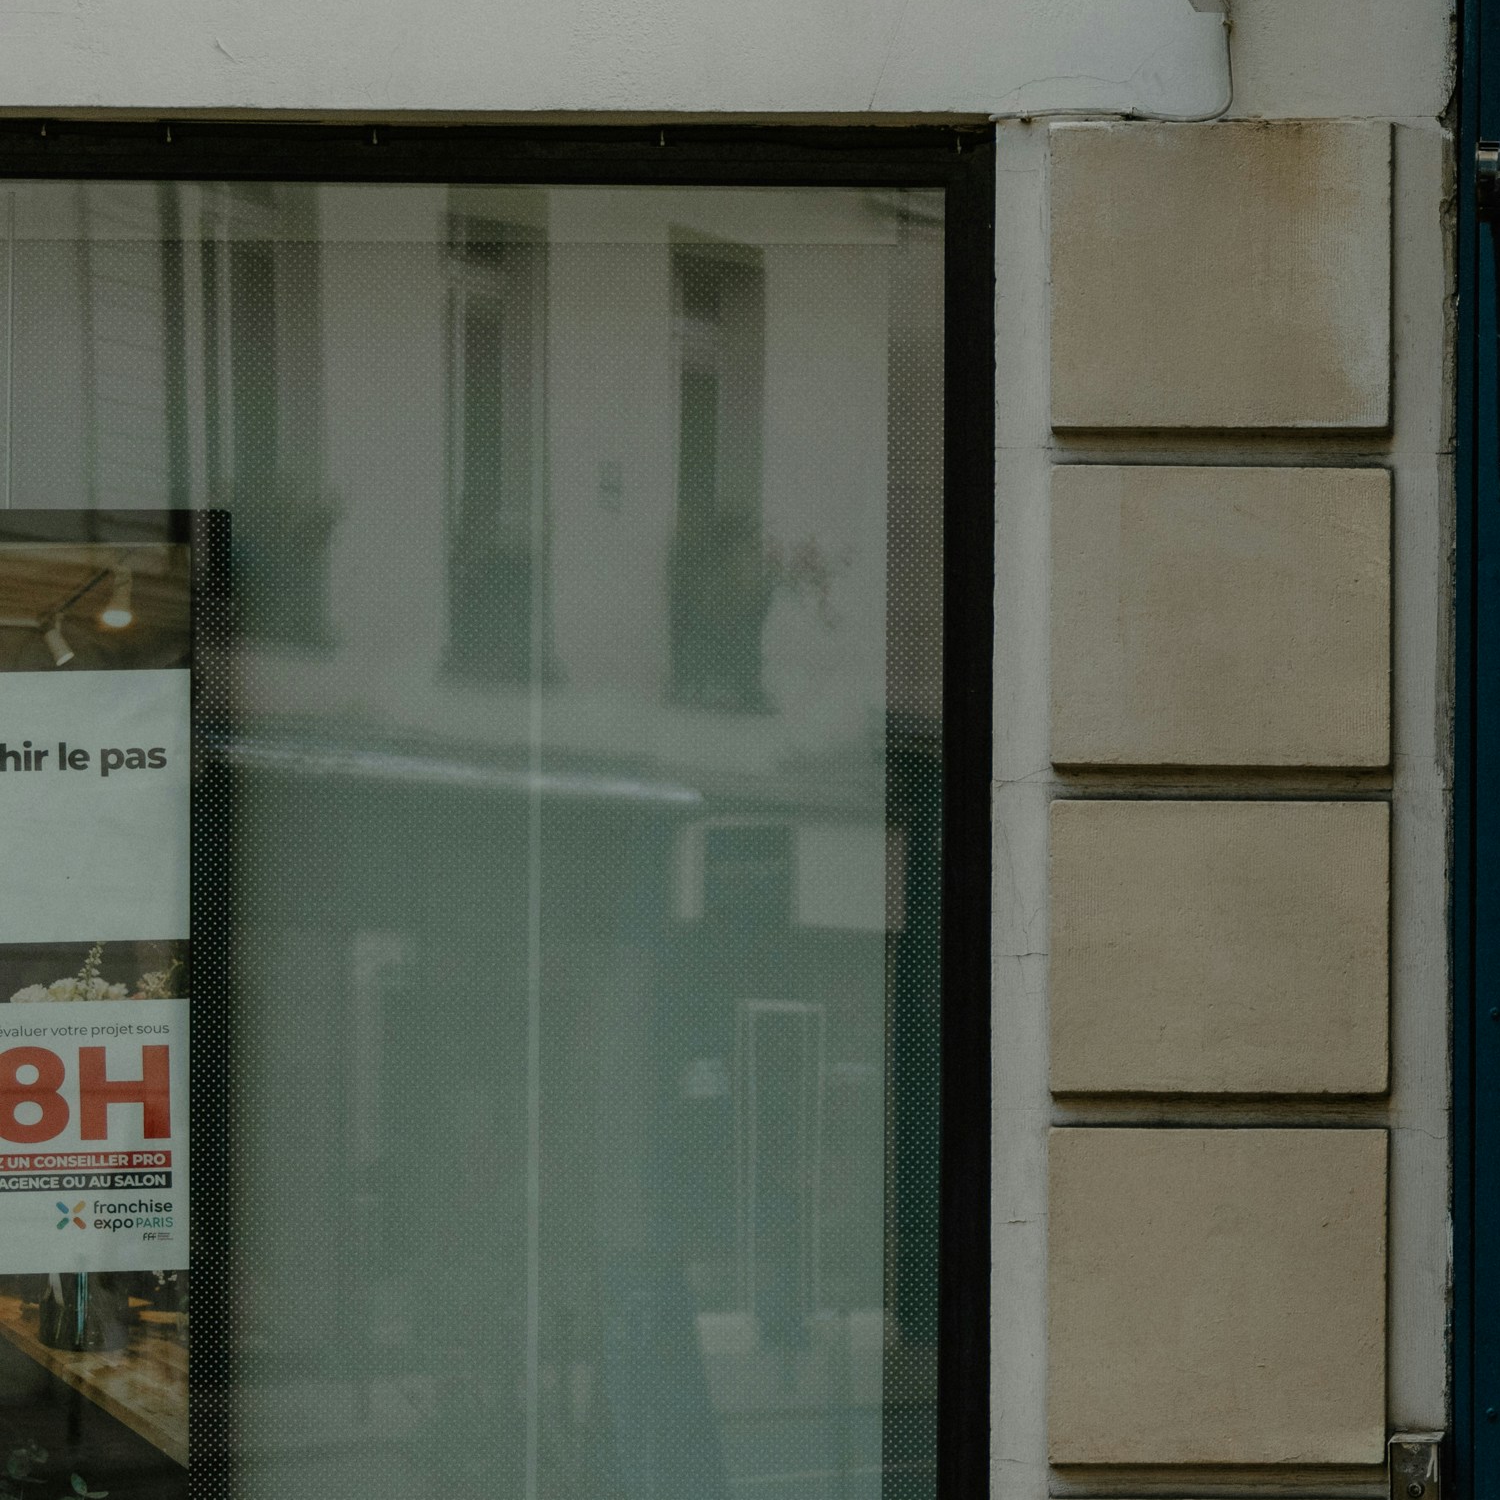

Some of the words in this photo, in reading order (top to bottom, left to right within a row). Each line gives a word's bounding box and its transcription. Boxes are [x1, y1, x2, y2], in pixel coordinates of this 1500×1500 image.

[0, 740, 49, 772] hir
[58, 742, 91, 771] le
[100, 747, 168, 777] pas
[51, 1025, 88, 1037] votre
[91, 1023, 134, 1038] projet
[136, 1024, 170, 1035] sous
[0, 1044, 171, 1144] 8H
[7, 1156, 31, 1169] UN
[34, 1154, 129, 1169] CONSEILLER
[132, 1153, 166, 1166] PRO
[0, 1177, 60, 1190] AGENCE
[62, 1176, 86, 1189] OU
[89, 1175, 111, 1188] AU
[114, 1174, 166, 1187] SALON
[93, 1199, 173, 1215] franchise
[93, 1217, 134, 1232] expo
[136, 1216, 174, 1228] PARIS
